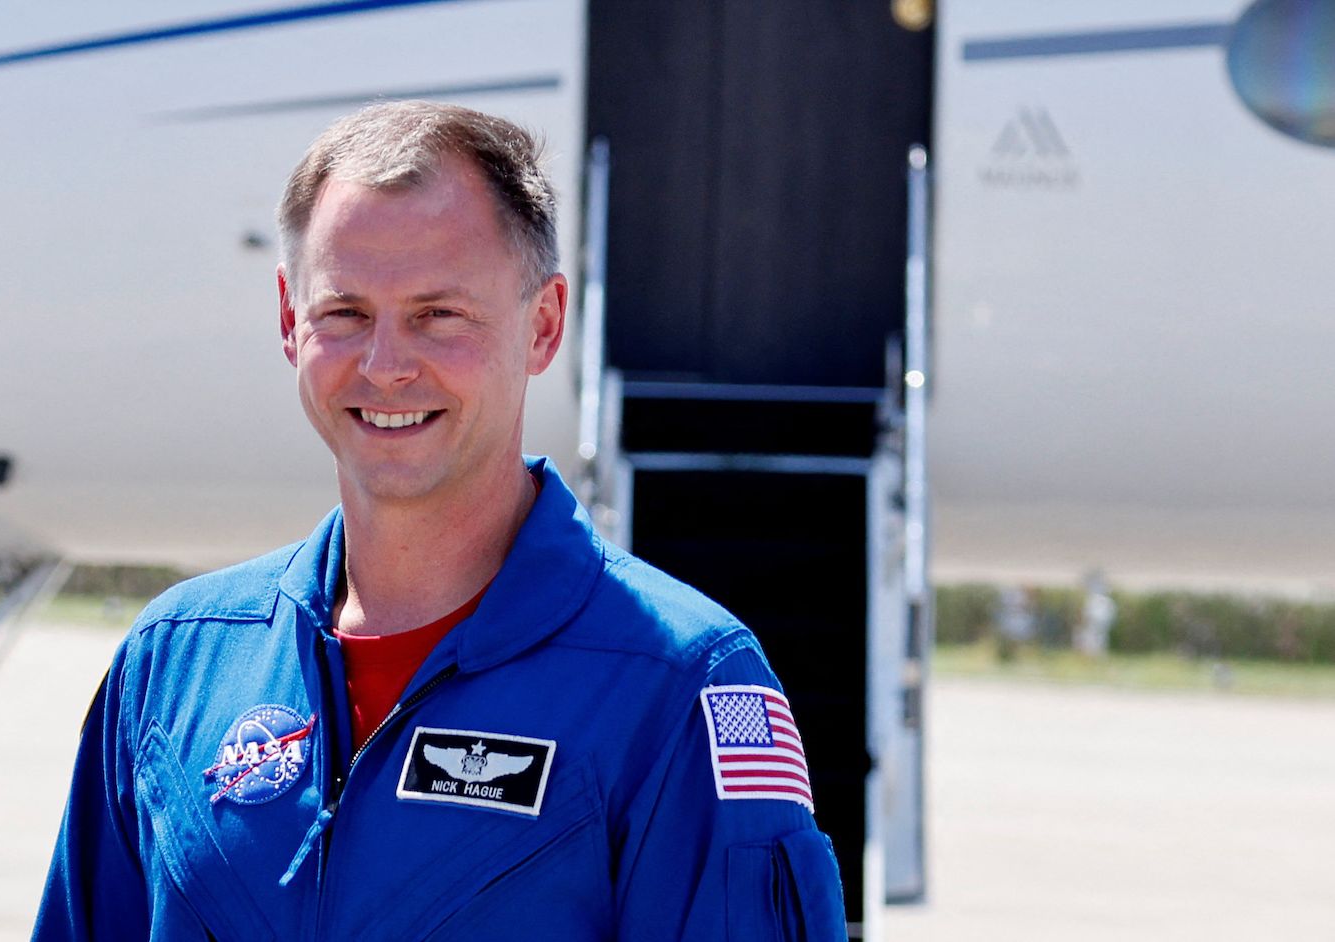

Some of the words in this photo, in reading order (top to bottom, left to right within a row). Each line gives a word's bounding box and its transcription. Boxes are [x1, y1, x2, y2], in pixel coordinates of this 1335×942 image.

[221, 740, 304, 766] NASA
[431, 779, 458, 793] NICK
[463, 783, 503, 799] HAGUE
